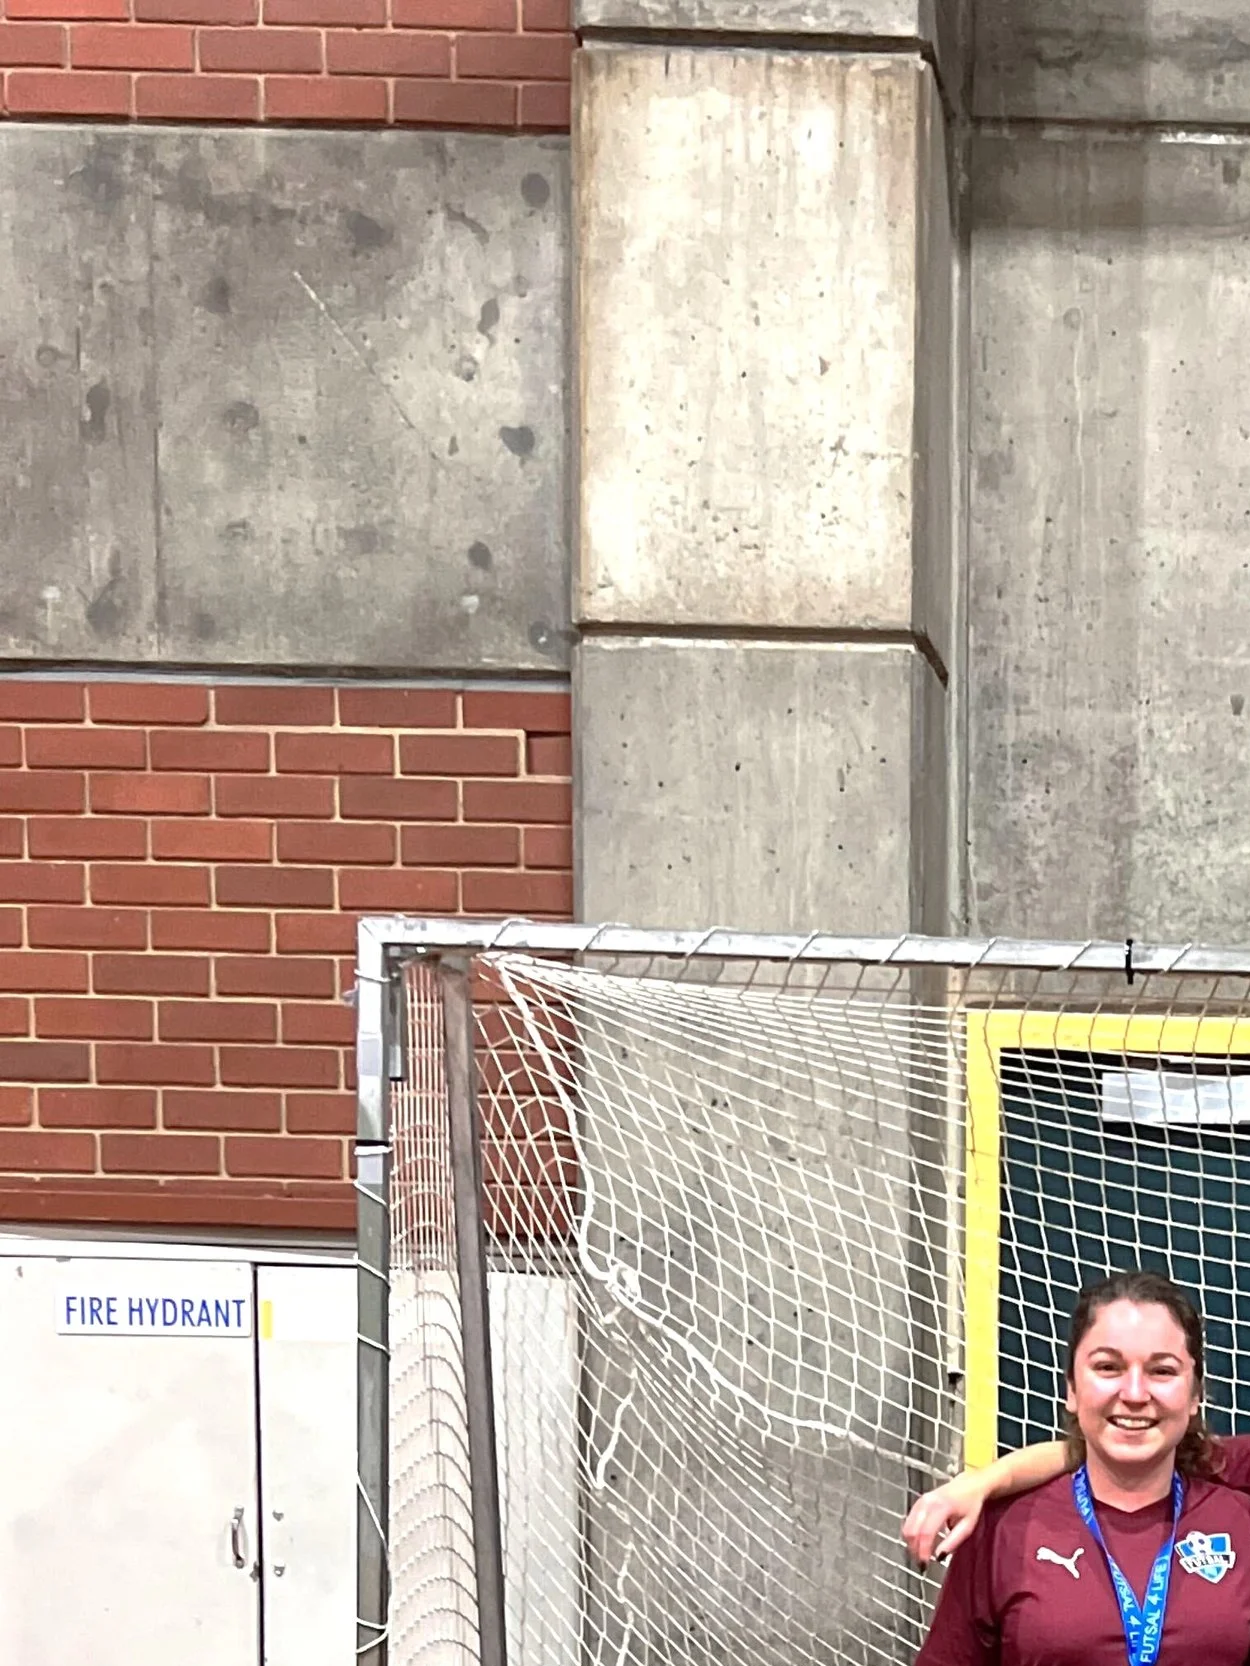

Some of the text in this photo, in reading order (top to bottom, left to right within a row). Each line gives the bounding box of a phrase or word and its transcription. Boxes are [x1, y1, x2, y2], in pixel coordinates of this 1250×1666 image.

[66, 1296, 246, 1328] FIRE HYDRANT
[1147, 1593, 1162, 1605] 4
